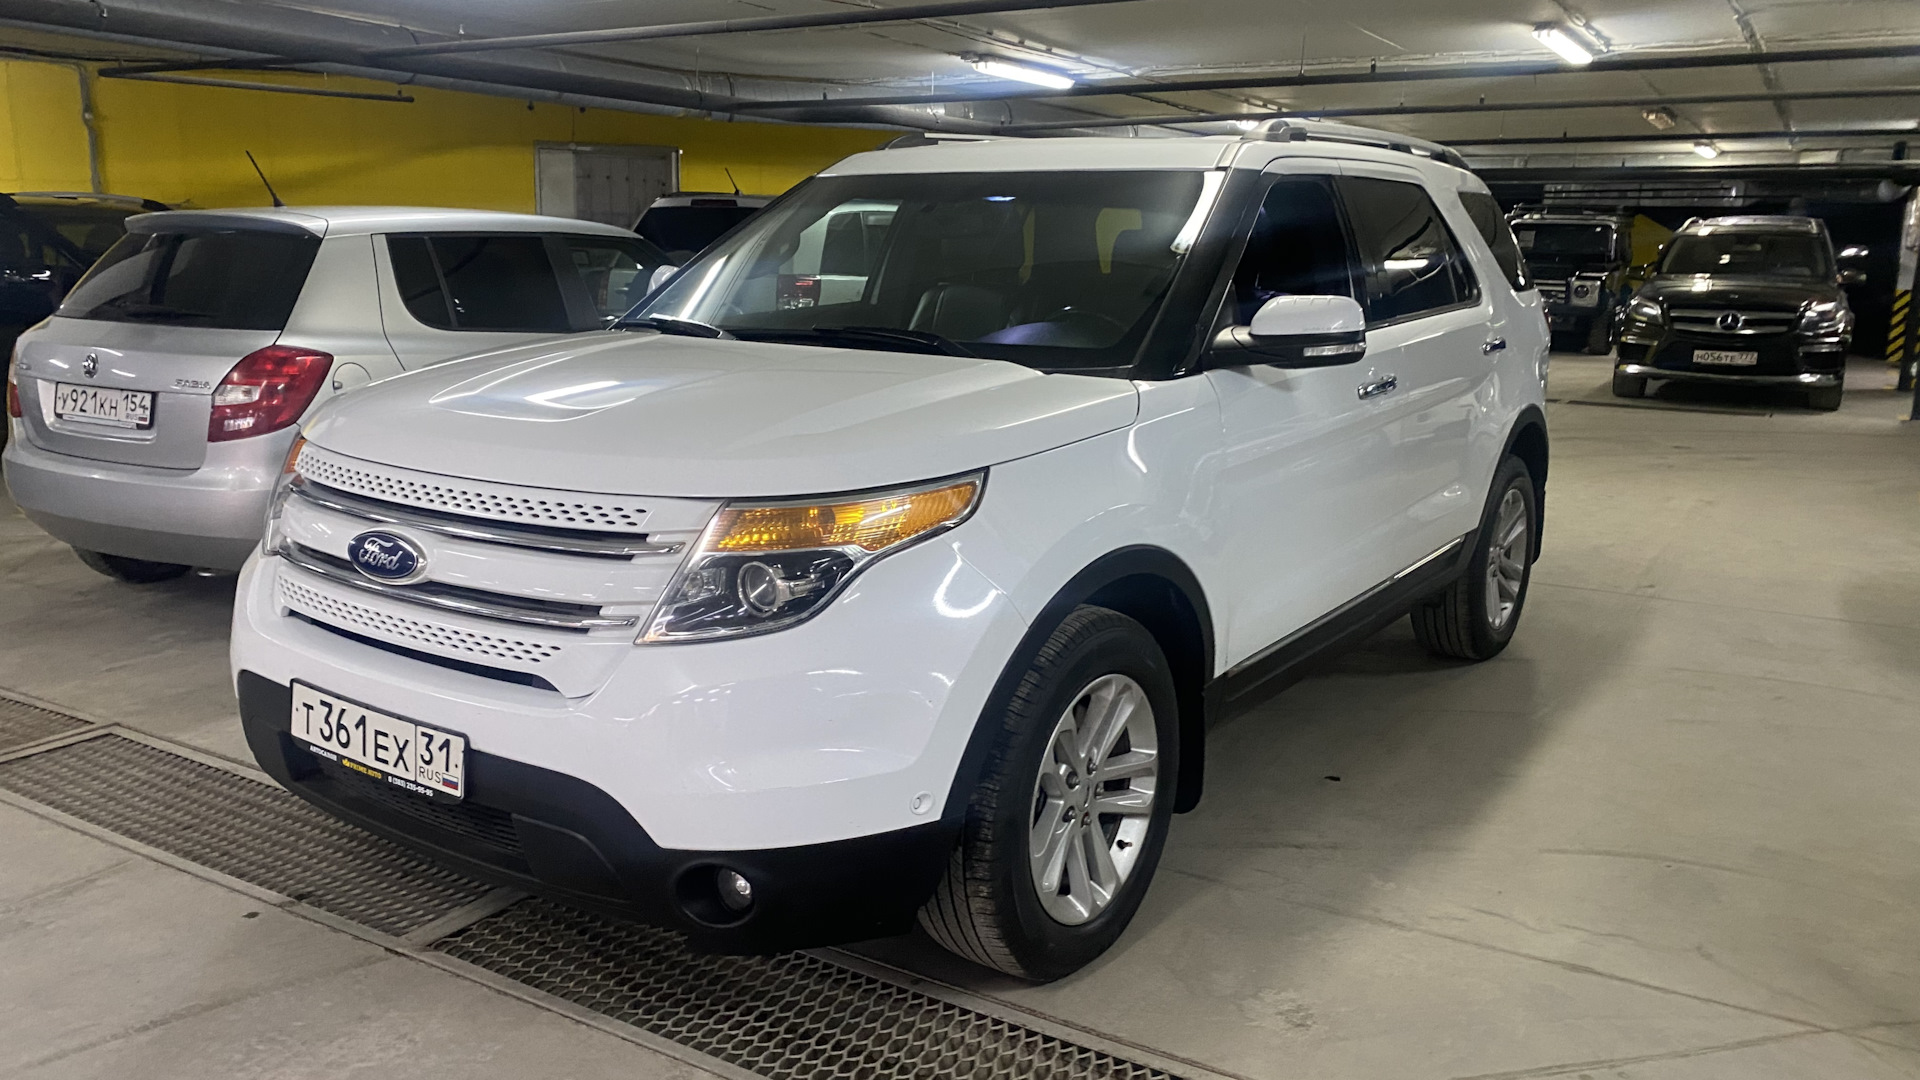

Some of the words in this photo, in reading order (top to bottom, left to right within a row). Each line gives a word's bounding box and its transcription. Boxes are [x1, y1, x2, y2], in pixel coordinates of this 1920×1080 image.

[61, 388, 118, 417] У921КН
[123, 393, 149, 414] 154
[358, 537, 403, 571] Ford
[302, 699, 410, 773] Т361ЕХ
[419, 731, 451, 772] 31
[418, 765, 441, 784] RUS
